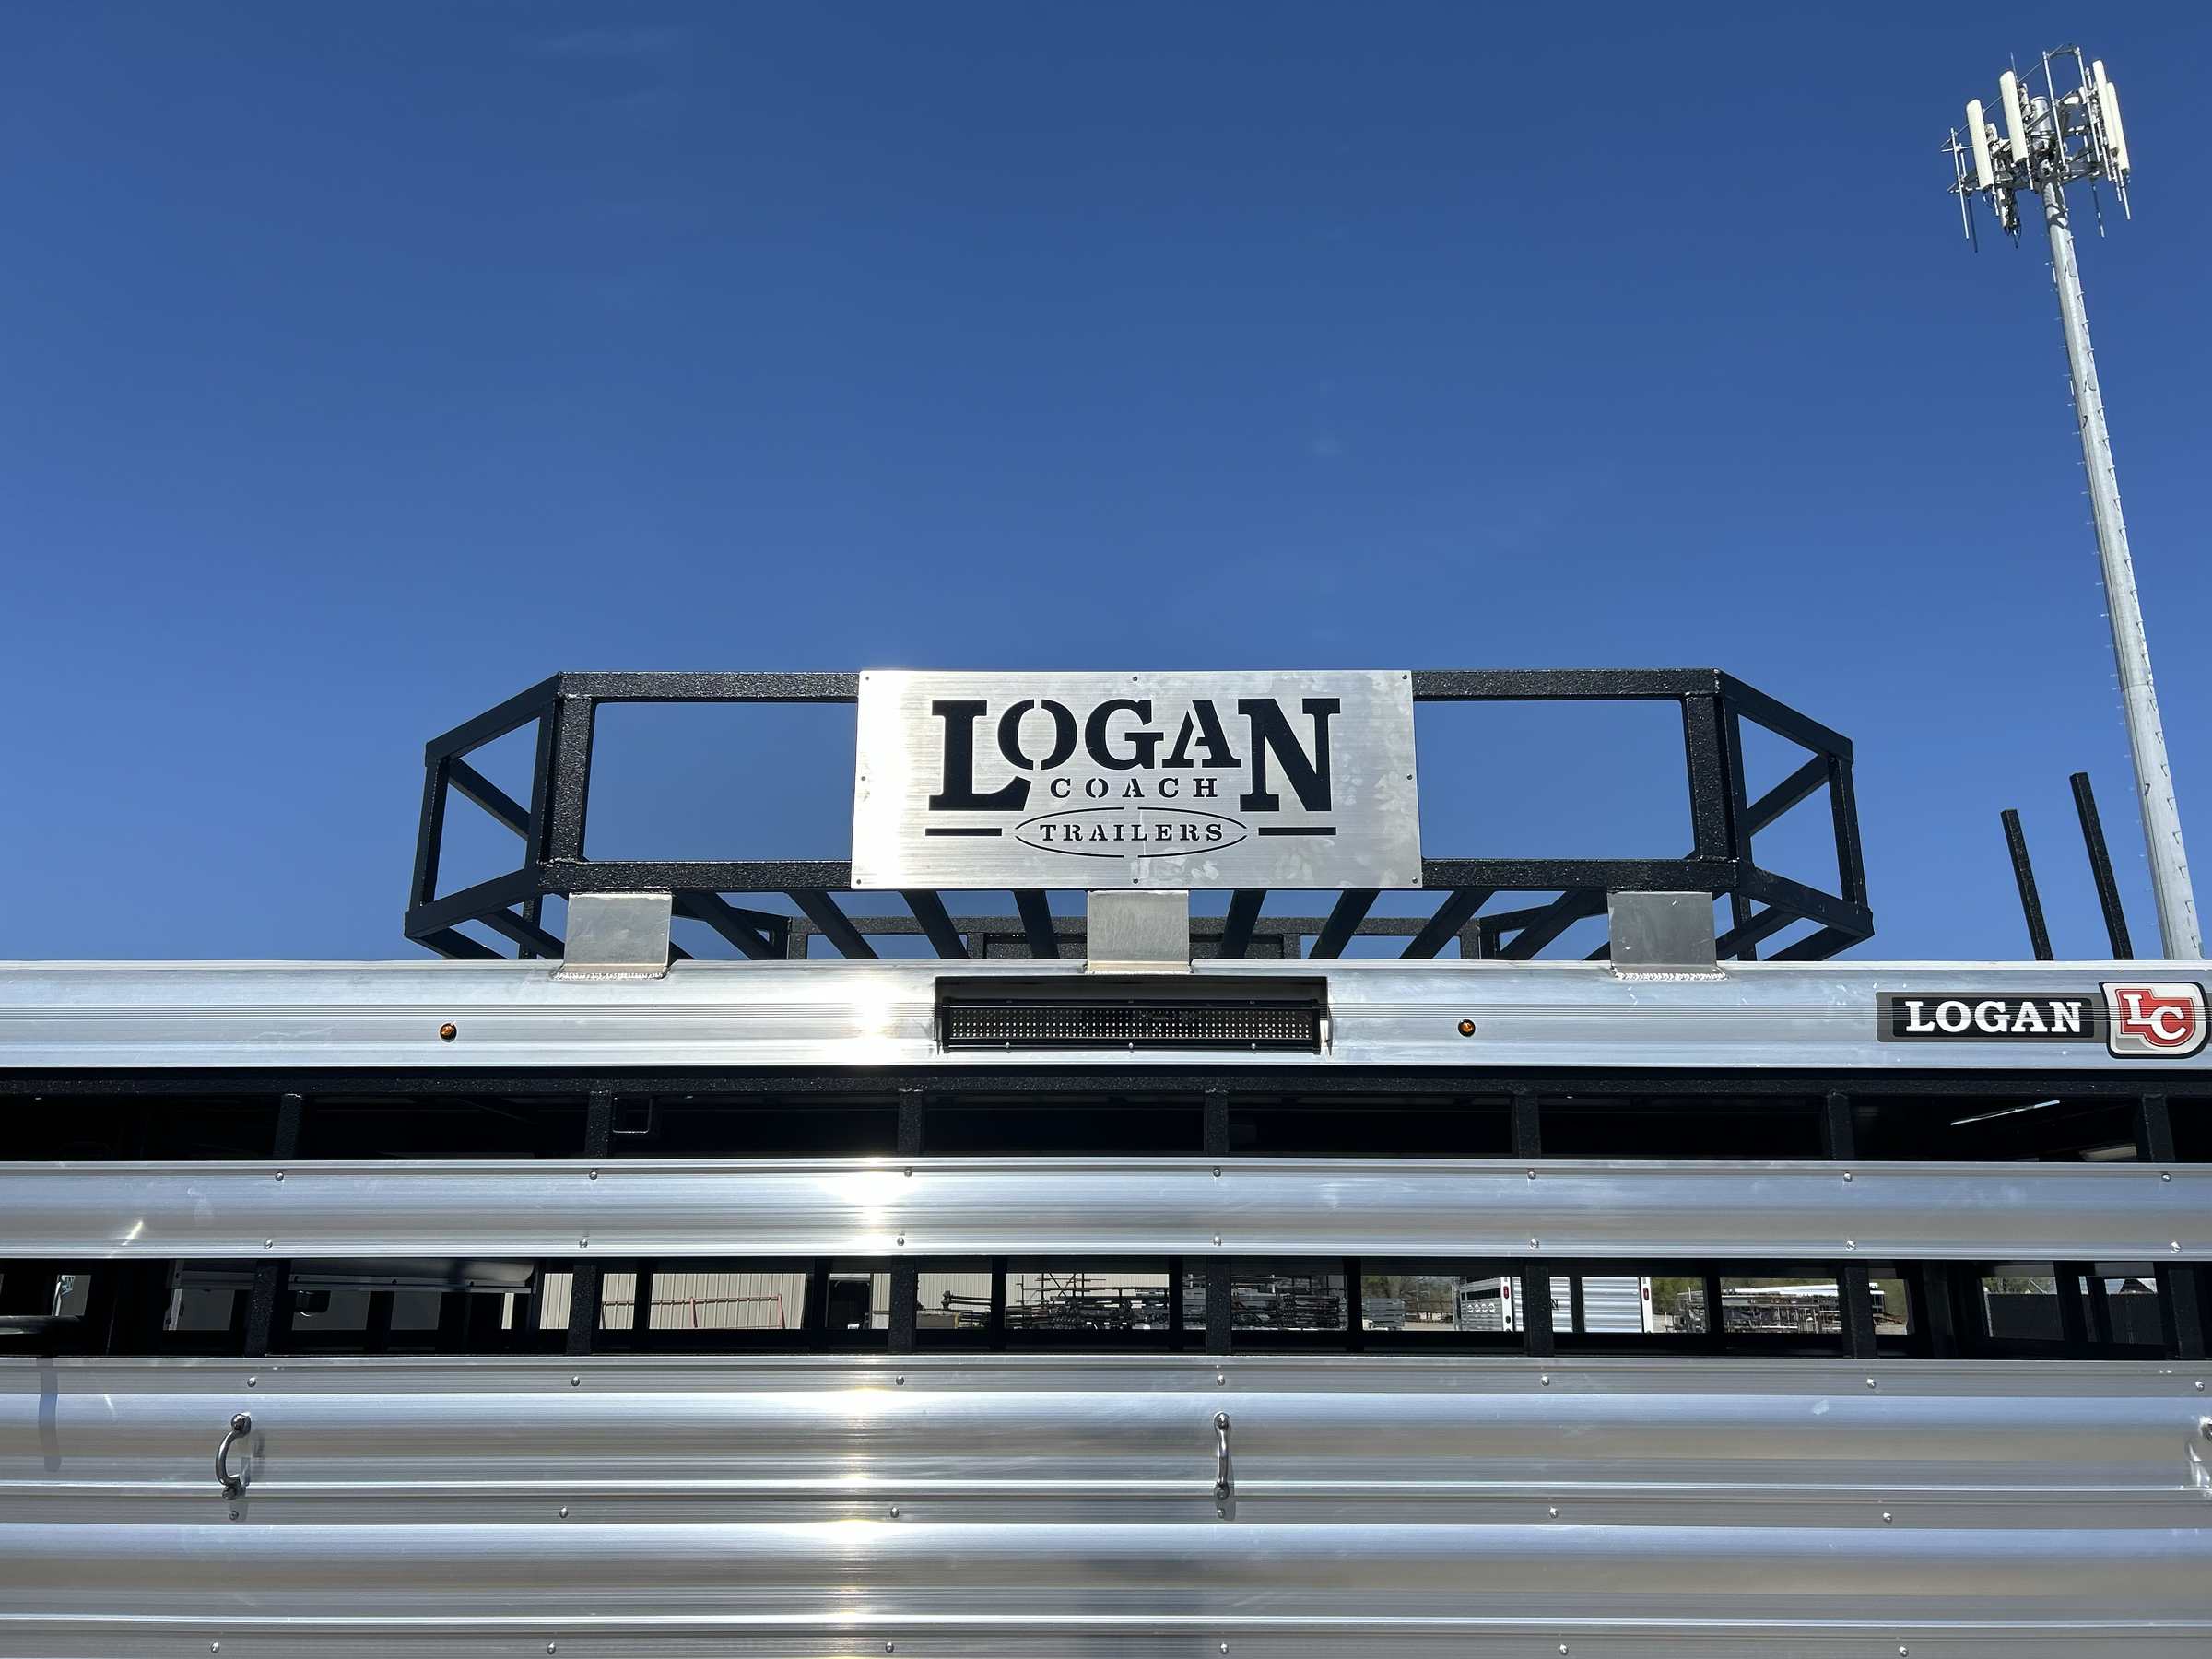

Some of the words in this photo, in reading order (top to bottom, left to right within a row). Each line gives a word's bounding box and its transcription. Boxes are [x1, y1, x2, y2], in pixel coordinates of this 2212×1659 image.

[929, 698, 1341, 812] LOGAN
[1050, 777, 1218, 799] COACH
[1039, 823, 1224, 841] TRAILERS
[1904, 1000, 2082, 1033] LOGAN
[2123, 994, 2187, 1041] LC
